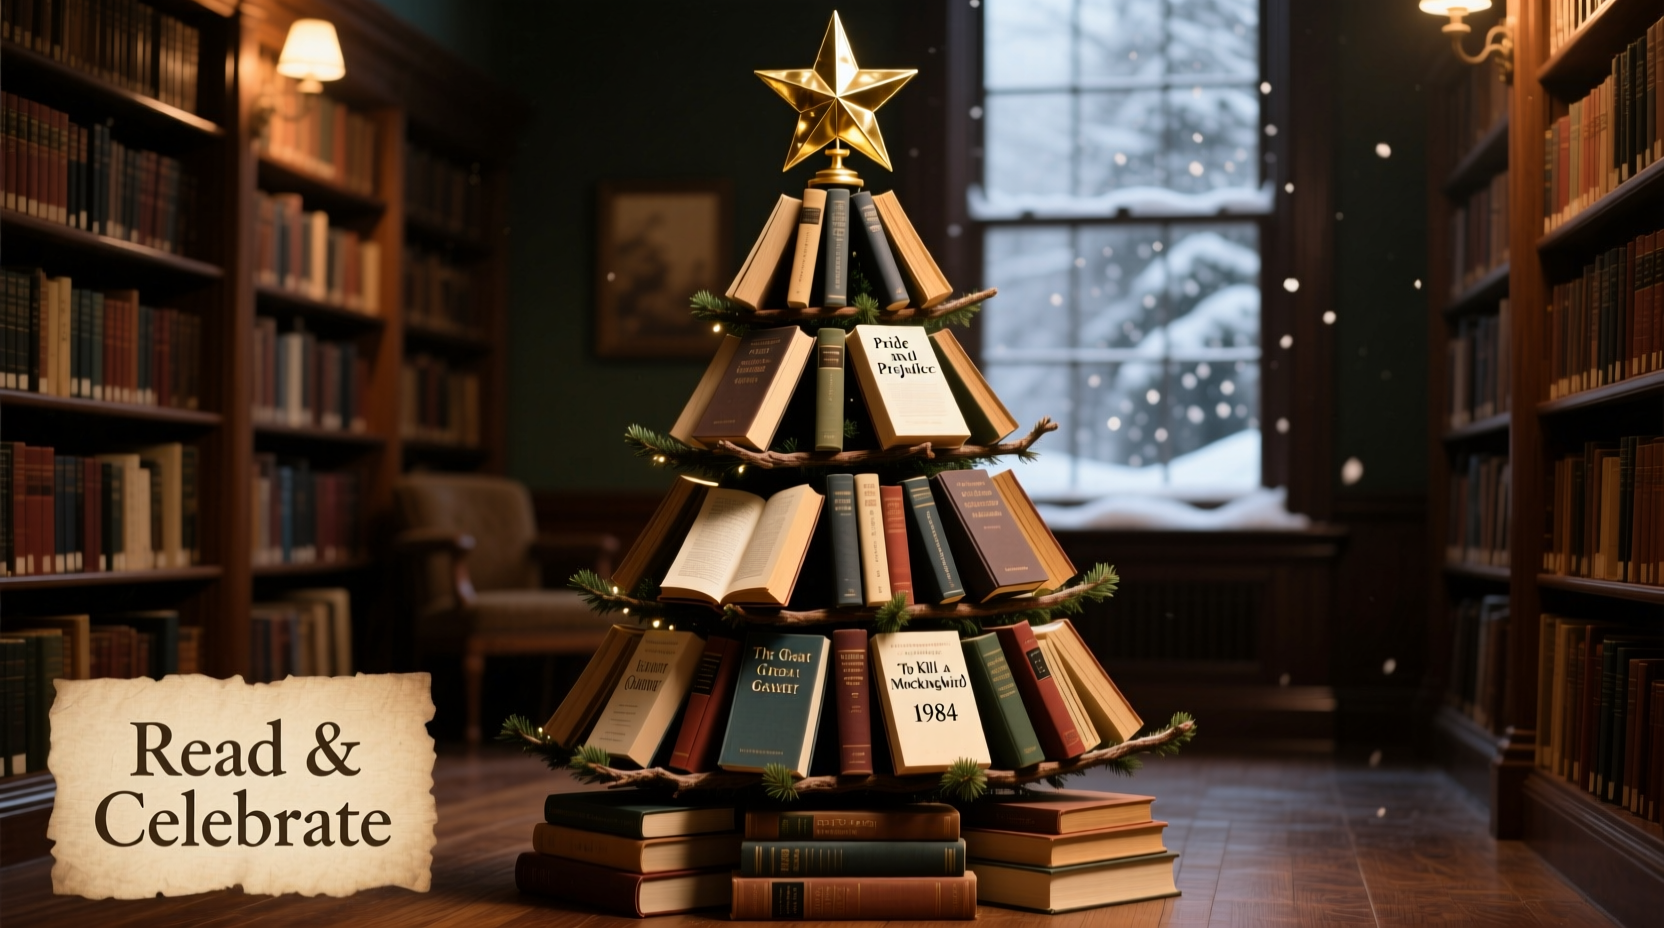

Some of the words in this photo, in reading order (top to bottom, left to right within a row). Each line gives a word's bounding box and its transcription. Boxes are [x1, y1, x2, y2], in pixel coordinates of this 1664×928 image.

[873, 335, 909, 349] Pride
[897, 662, 914, 675] To
[916, 660, 939, 674] Kill
[913, 702, 959, 723] 1984
[129, 718, 287, 778] Read
[305, 720, 362, 778] &
[93, 788, 392, 848] Celebrate
